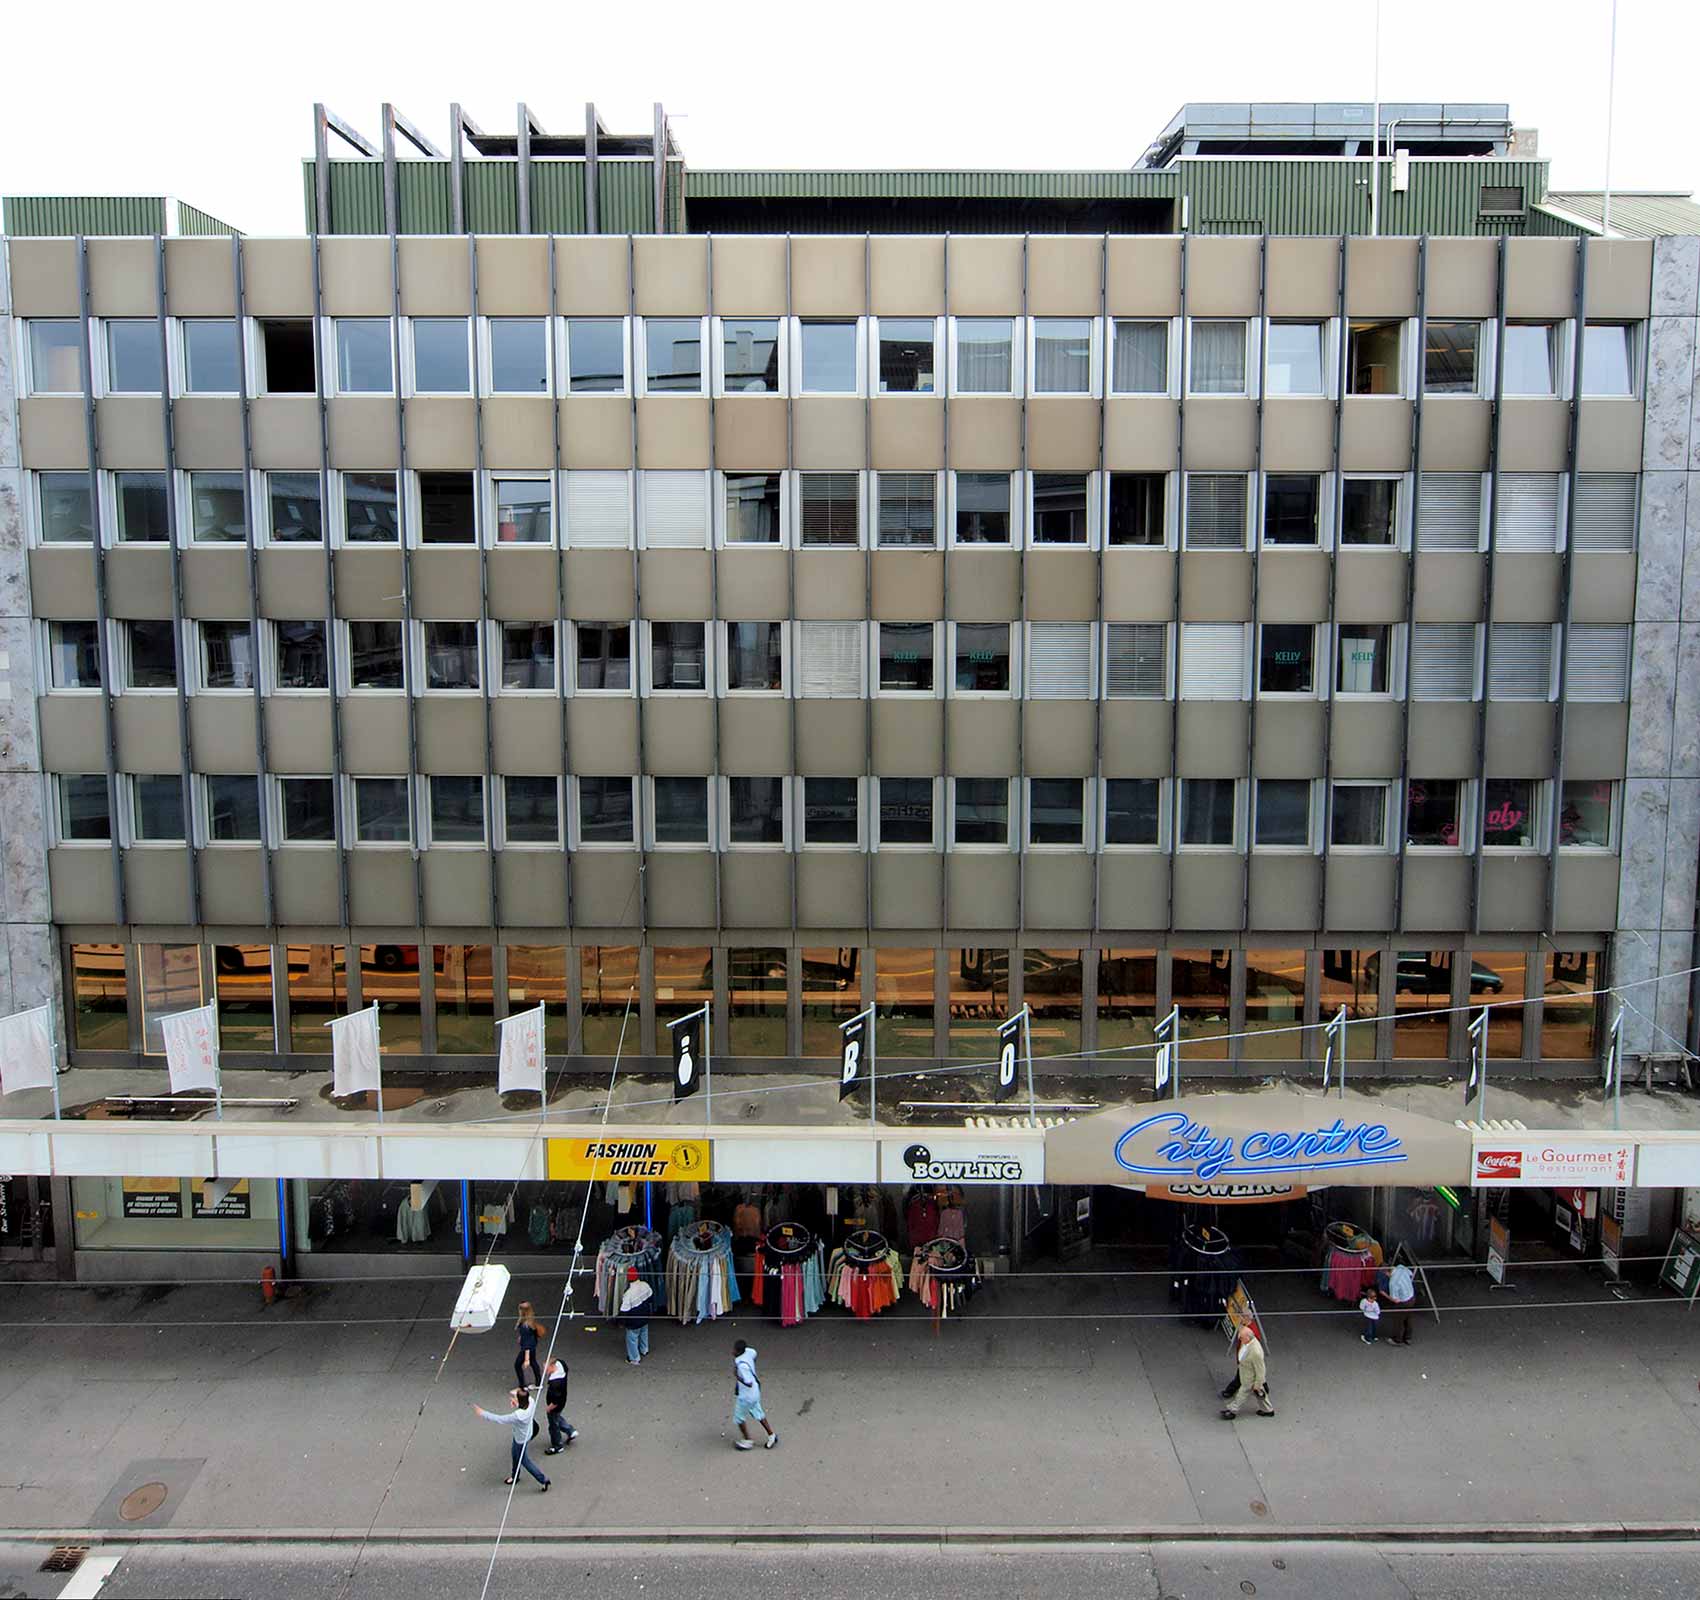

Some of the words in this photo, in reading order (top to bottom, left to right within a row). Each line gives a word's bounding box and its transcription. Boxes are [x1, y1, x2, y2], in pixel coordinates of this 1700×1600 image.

[1274, 651, 1301, 661] KELLY
[1351, 651, 1377, 661] KELLY
[843, 1040, 860, 1085] B
[584, 1143, 658, 1159] FASHION
[1114, 1111, 1235, 1181] City
[1241, 1118, 1402, 1162] centre
[1526, 1154, 1539, 1162] Le
[1541, 1148, 1613, 1163] Gourmet
[609, 1161, 669, 1176] OUTLET
[912, 1160, 1023, 1180] BOWLING
[1539, 1163, 1613, 1173] Restaurant
